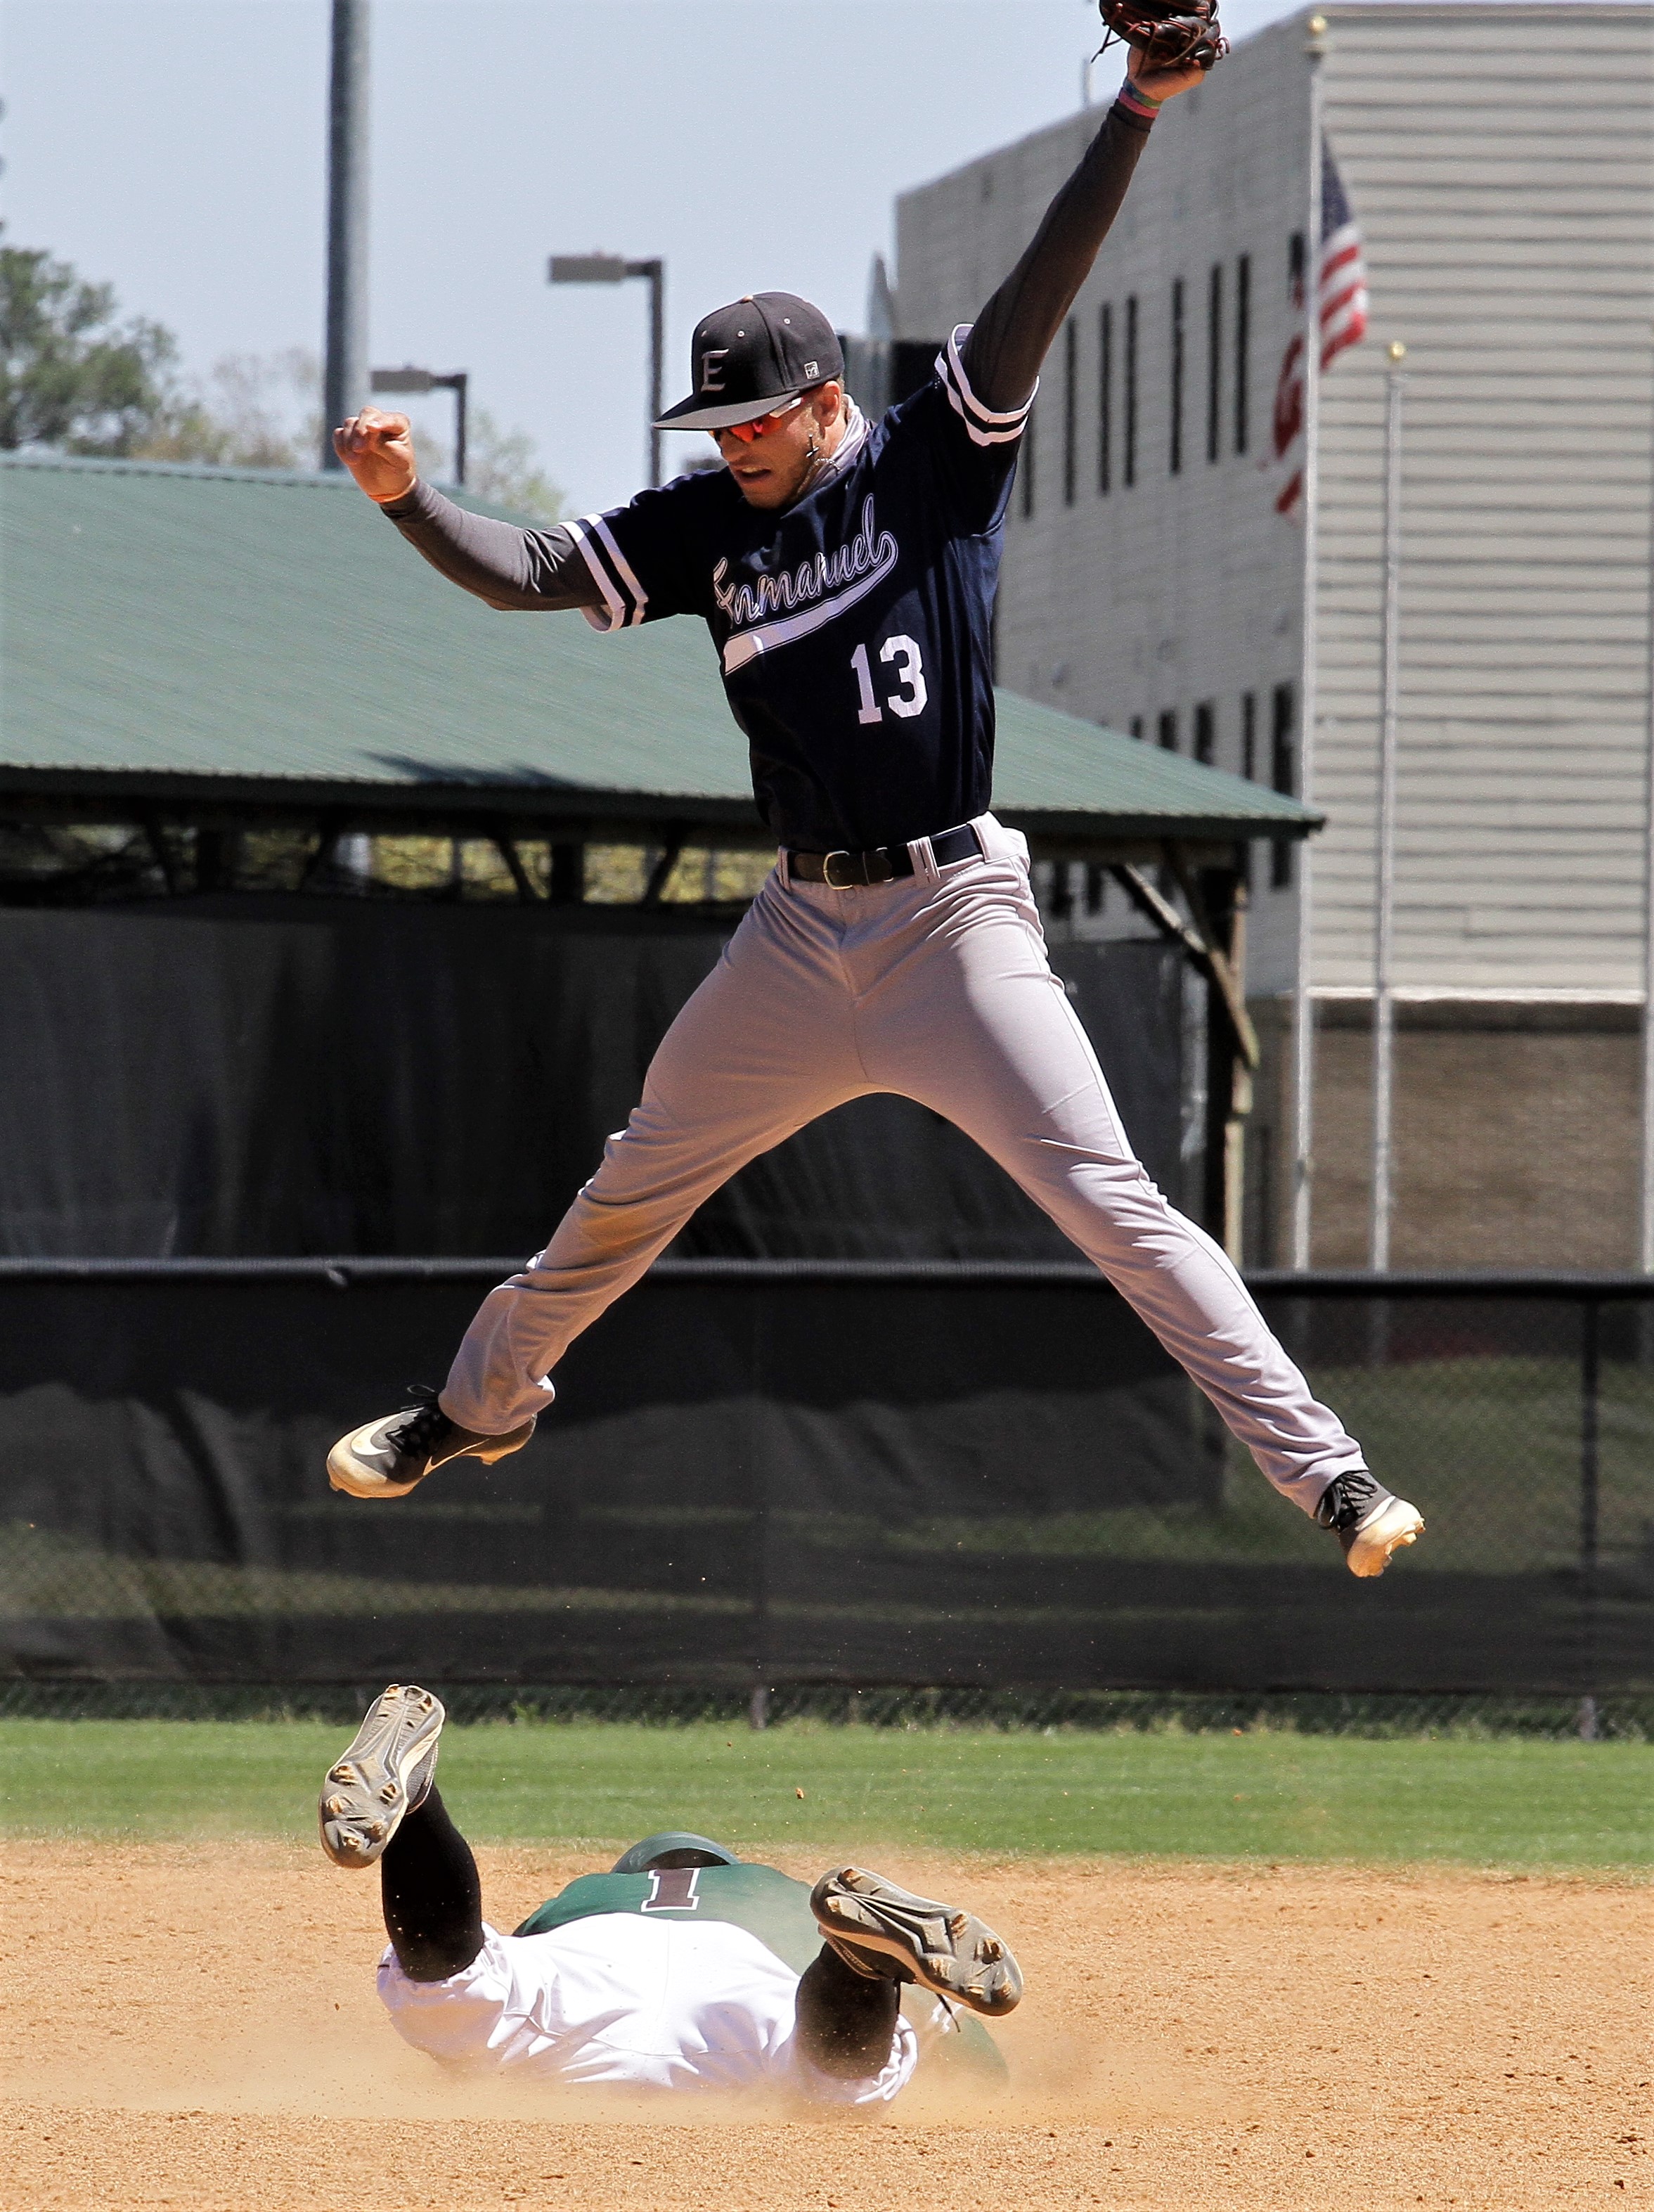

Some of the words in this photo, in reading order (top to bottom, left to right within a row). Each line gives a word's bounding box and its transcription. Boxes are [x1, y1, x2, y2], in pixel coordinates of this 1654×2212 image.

[701, 348, 729, 392] E
[851, 634, 928, 724] 13
[640, 1867, 701, 1912] 1
